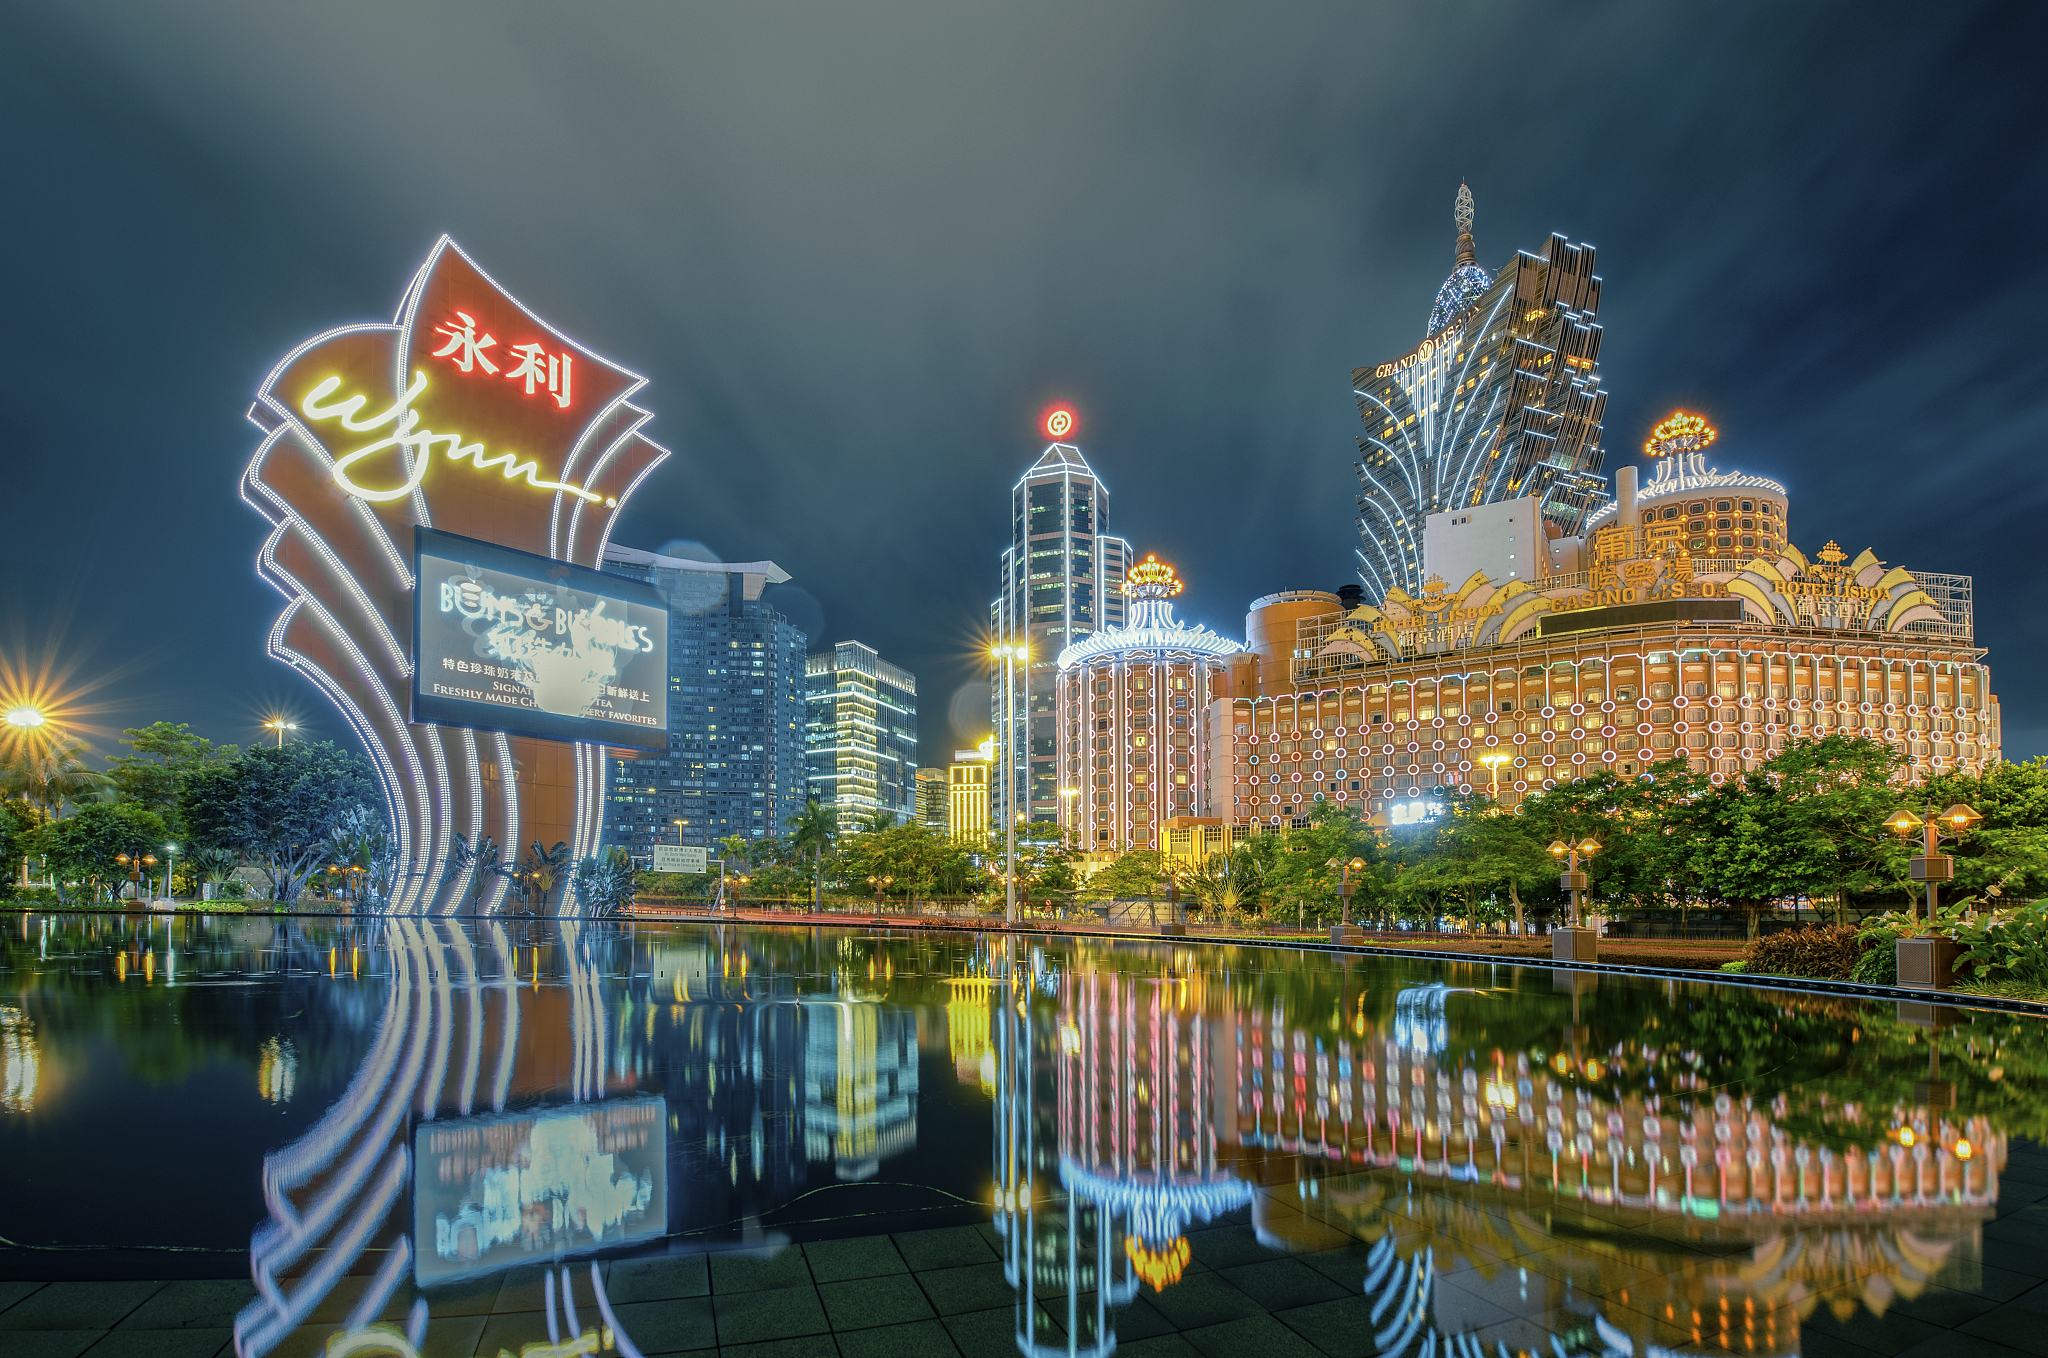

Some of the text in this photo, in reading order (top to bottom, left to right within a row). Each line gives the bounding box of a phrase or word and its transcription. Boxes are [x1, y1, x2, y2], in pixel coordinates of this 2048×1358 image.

[432, 311, 573, 408] 永利
[1376, 353, 1418, 378] GRAND
[1595, 520, 1686, 562] 葡京
[1551, 582, 1731, 613] CASINO LISBOA
[1773, 580, 1893, 601] HOTEL LISBOA
[1372, 603, 1505, 633] HOTEL LISBOA
[442, 657, 541, 683] 特色珍珠奶茶及
[433, 683, 657, 725] FRESHLY MADE CH ERY FAVORITES
[493, 681, 613, 708] SIGNAT TEA
